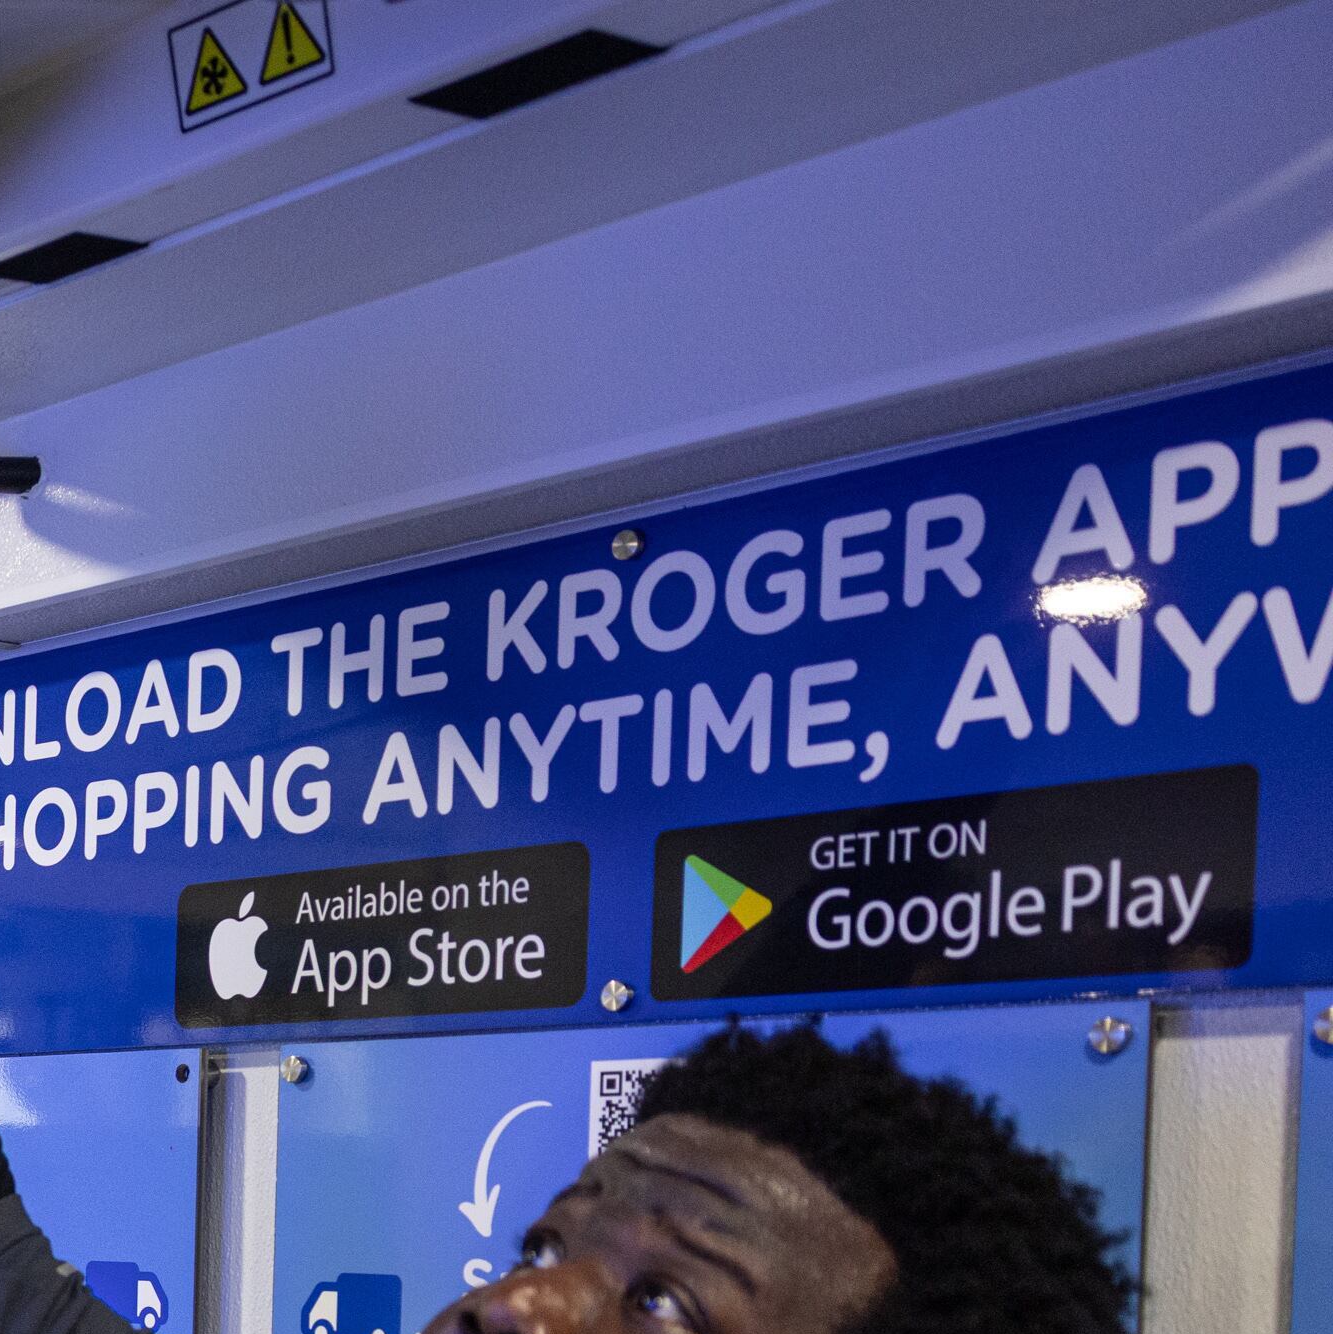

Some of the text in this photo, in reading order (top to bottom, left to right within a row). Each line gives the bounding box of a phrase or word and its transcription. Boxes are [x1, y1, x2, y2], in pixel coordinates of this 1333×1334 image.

[271, 601, 450, 717] THE
[486, 493, 986, 681] KROGER
[1032, 418, 1333, 583] APP
[362, 658, 889, 825] ANYTIME,
[810, 820, 987, 870] GET IT ON
[295, 869, 530, 924] Available on the
[806, 858, 1213, 959] Google Play
[291, 926, 545, 1007] App Store
